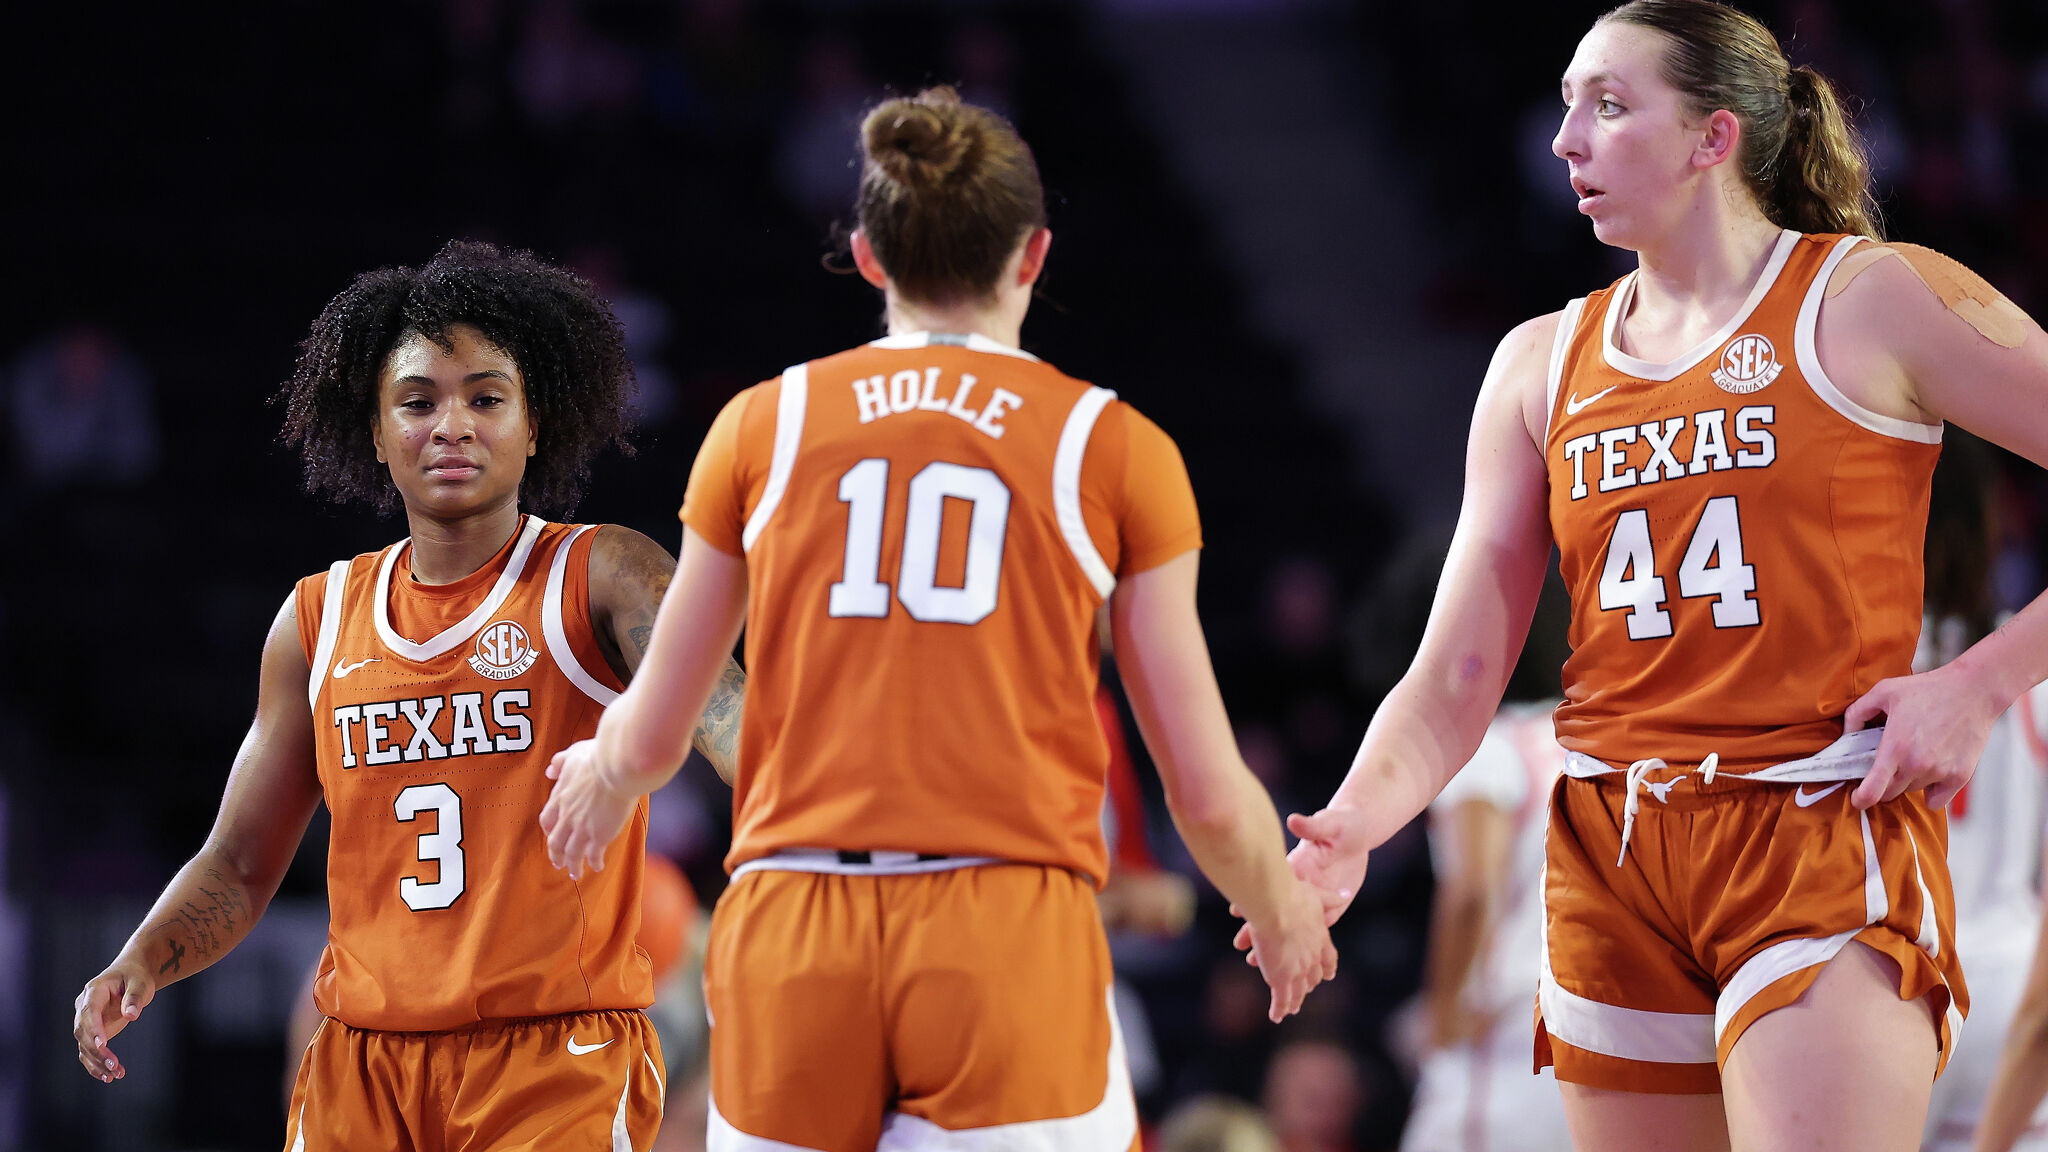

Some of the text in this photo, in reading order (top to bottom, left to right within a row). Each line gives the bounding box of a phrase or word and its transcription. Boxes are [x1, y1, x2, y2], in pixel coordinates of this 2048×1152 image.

[1717, 374, 1771, 393] GRADUATE
[1725, 337, 1770, 379] SEC
[852, 366, 1023, 439] HOLLE
[1564, 405, 1776, 501] TEXAS
[828, 458, 1012, 625] 10
[1598, 496, 1761, 641] 44
[475, 660, 530, 679] GRADUATE
[481, 624, 525, 666] SEC
[334, 689, 534, 769] TEXAS
[394, 782, 466, 912] 3
